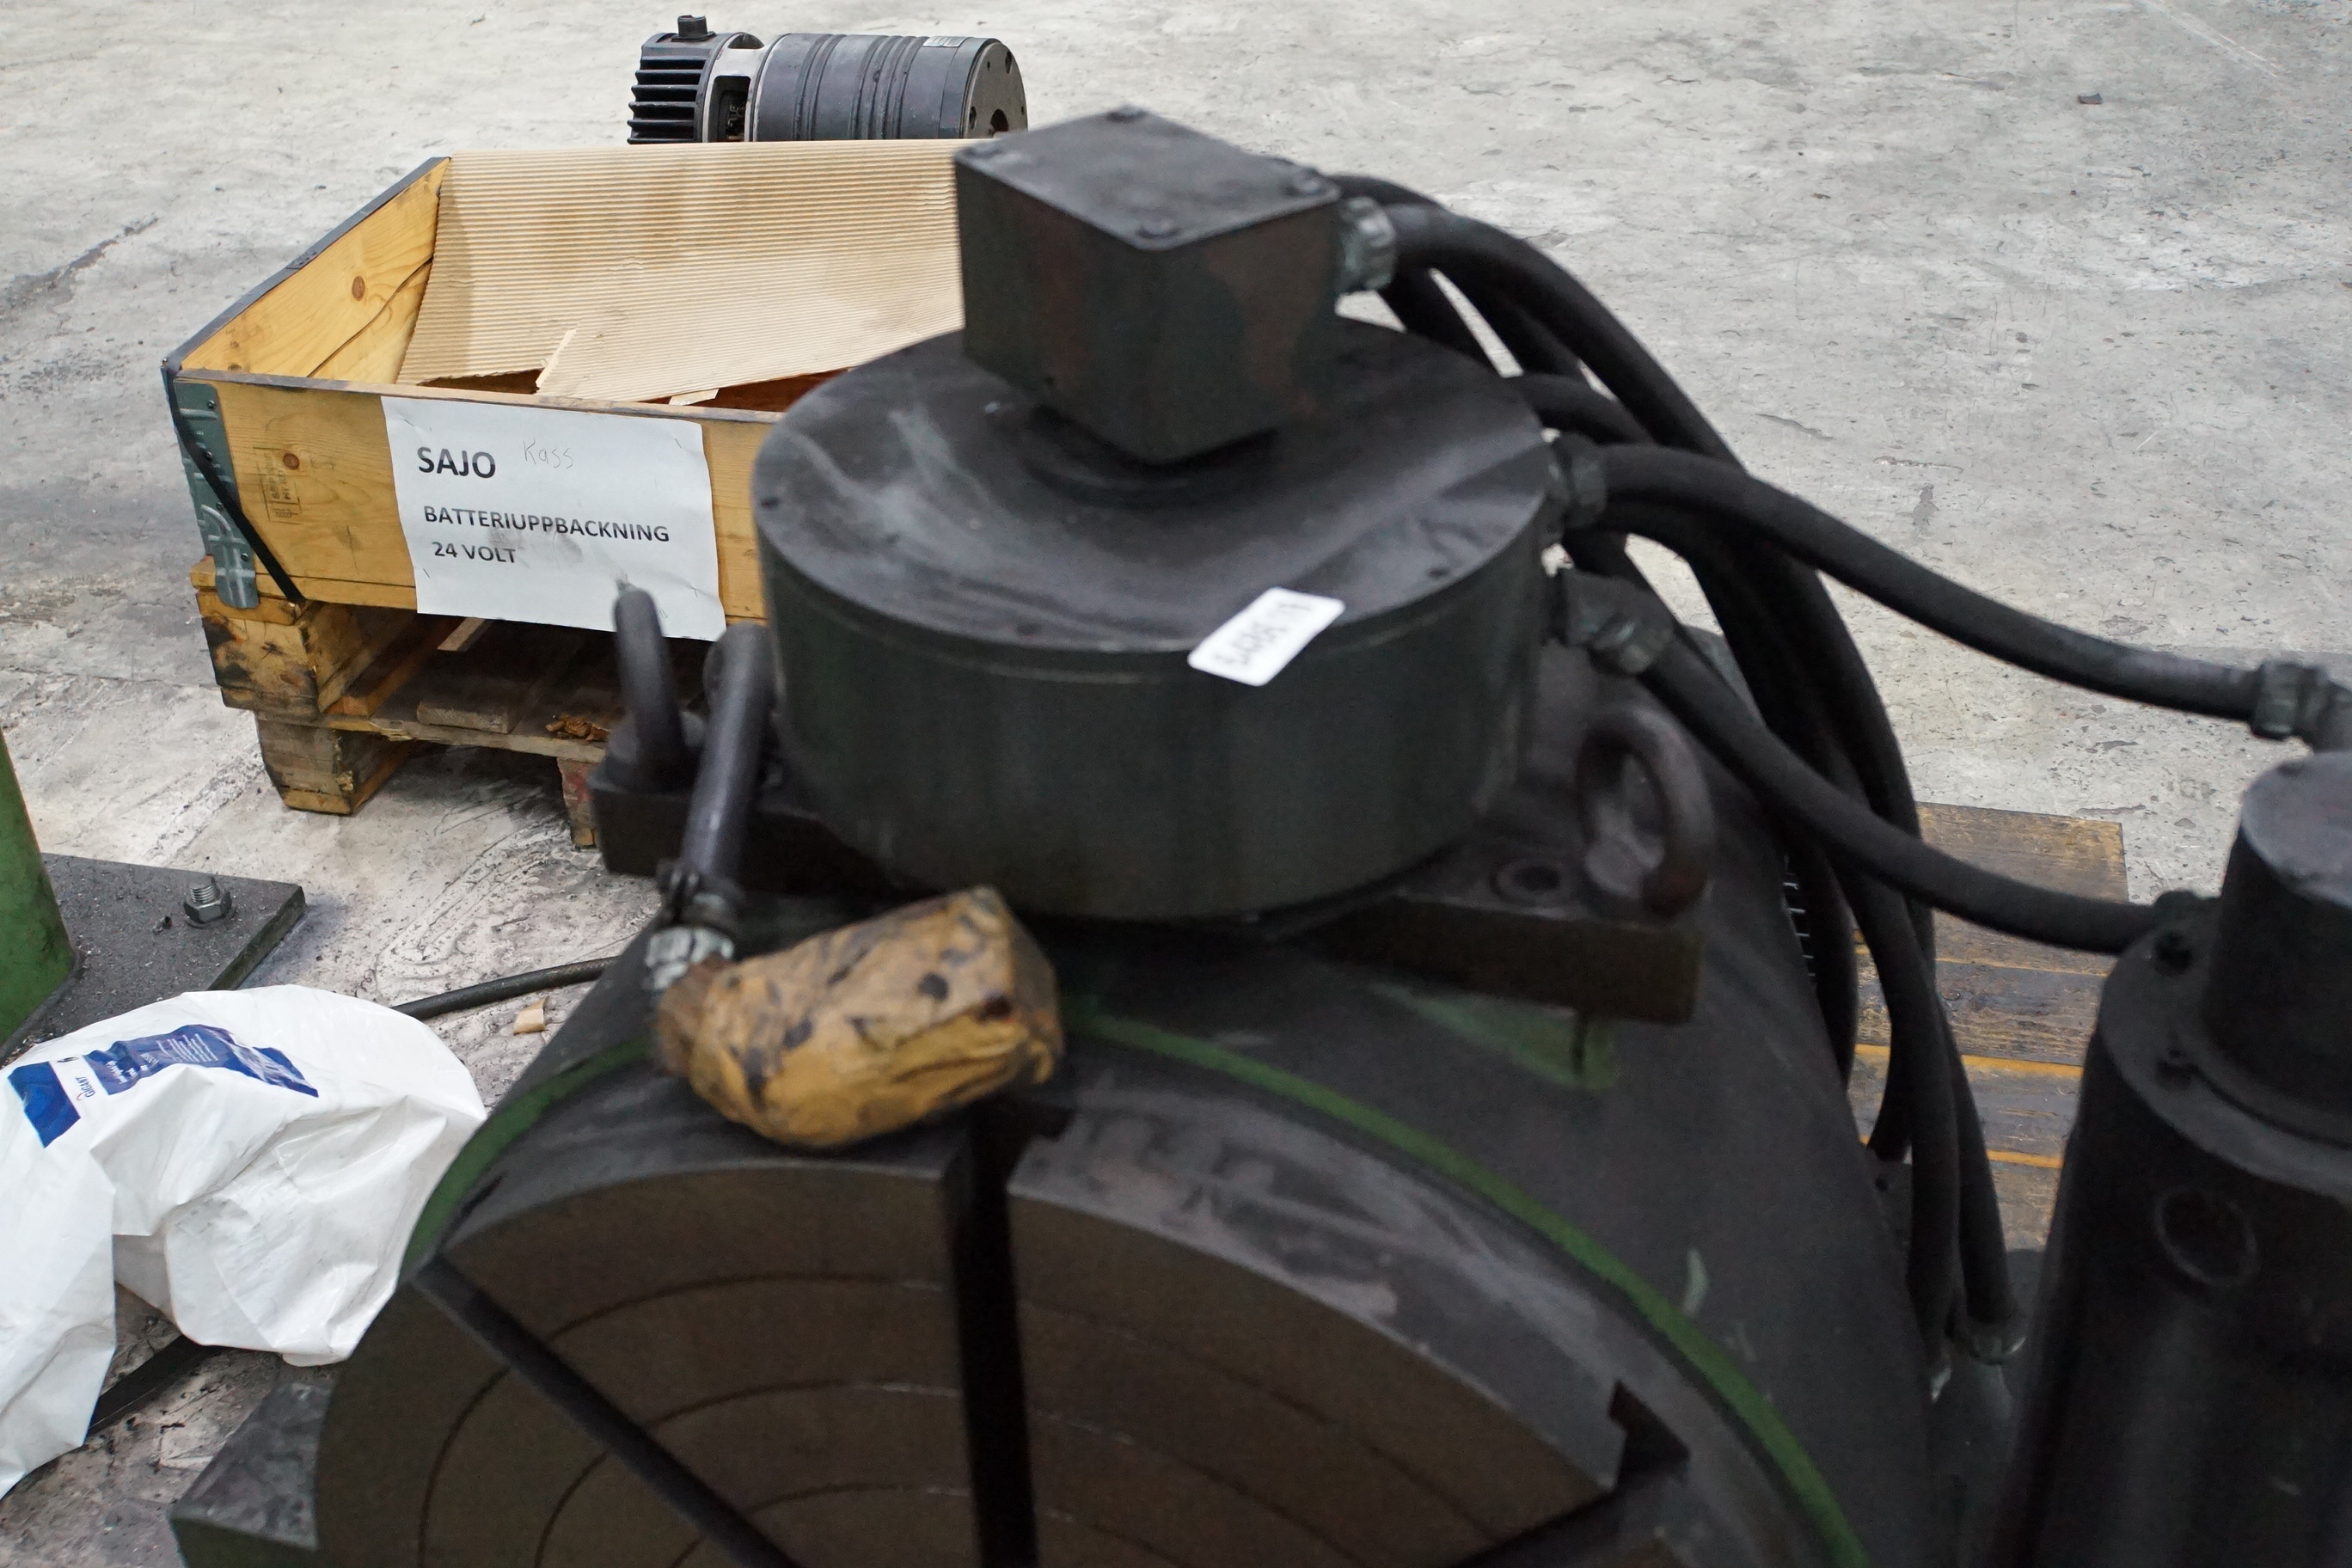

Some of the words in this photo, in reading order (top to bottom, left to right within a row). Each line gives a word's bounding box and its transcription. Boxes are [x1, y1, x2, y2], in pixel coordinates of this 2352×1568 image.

[417, 446, 496, 479] SAJO
[424, 505, 670, 542] BATTERIUPPBACKNING
[433, 541, 457, 558] 24
[461, 544, 517, 563] VOLT
